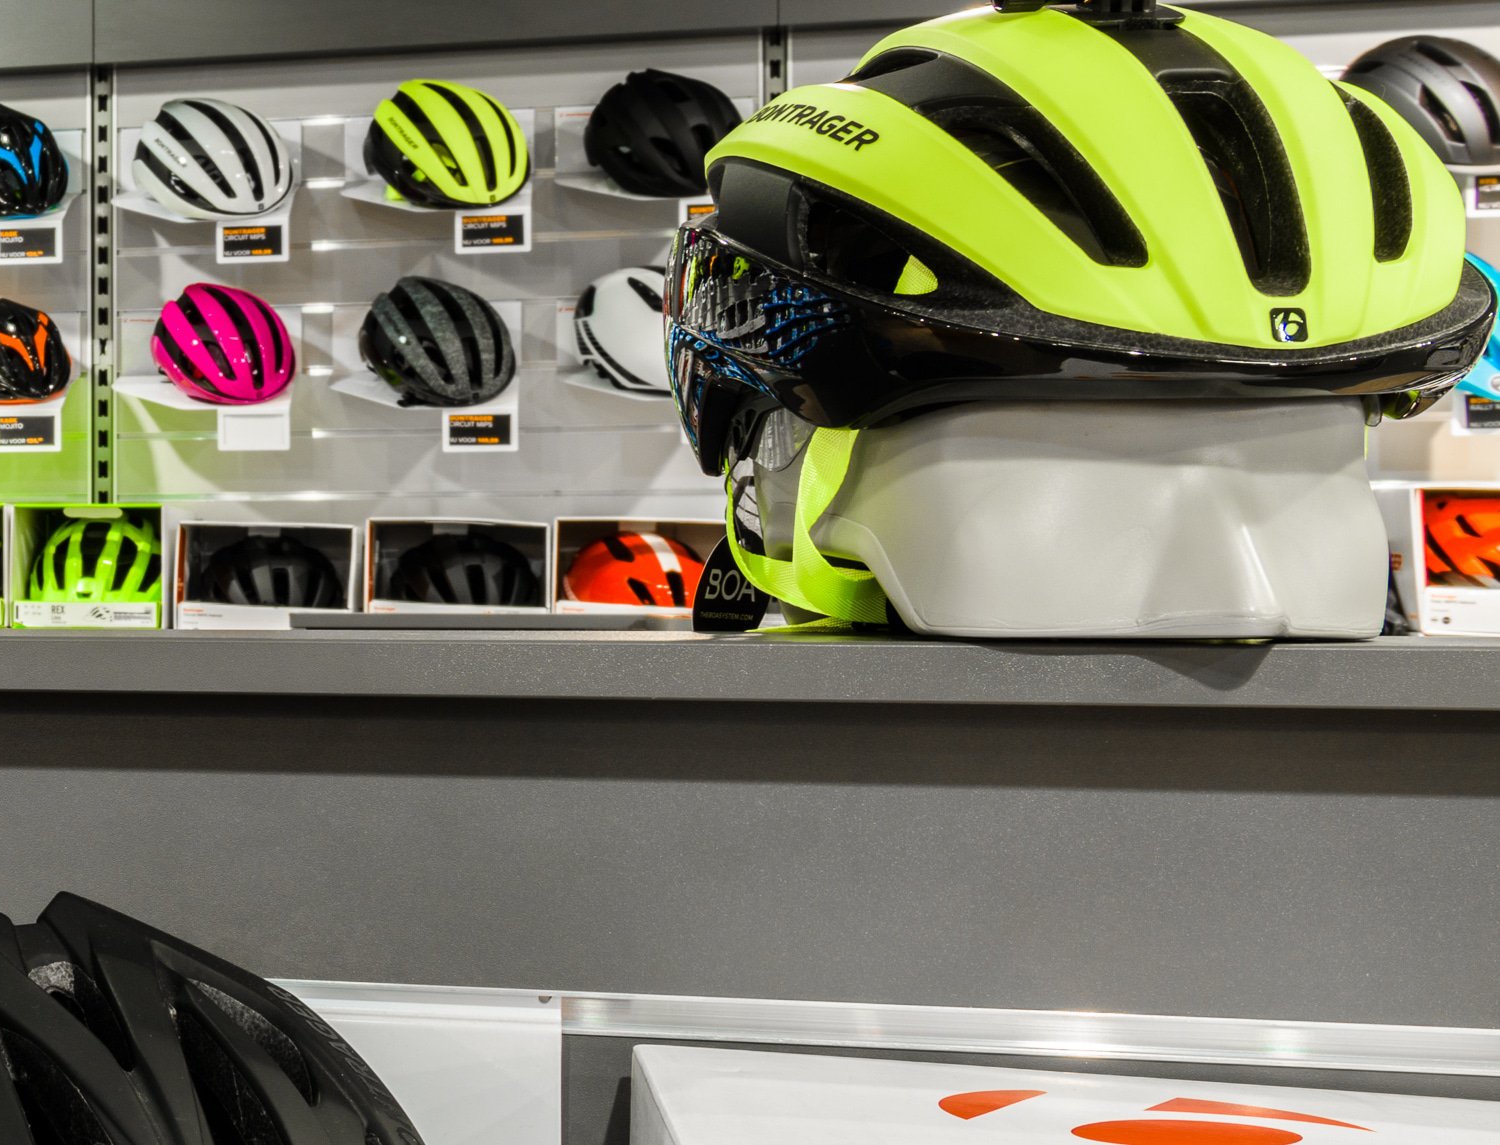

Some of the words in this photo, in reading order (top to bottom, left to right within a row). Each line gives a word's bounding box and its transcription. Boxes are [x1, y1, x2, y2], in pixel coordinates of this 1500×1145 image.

[388, 117, 418, 149] BONTRAGER
[746, 104, 880, 151] BONTRAGER
[462, 216, 507, 224] BONTRAGER
[705, 569, 755, 602] BOA
[50, 605, 66, 615] REX
[700, 611, 753, 620] THEBOASYSTEM.COM
